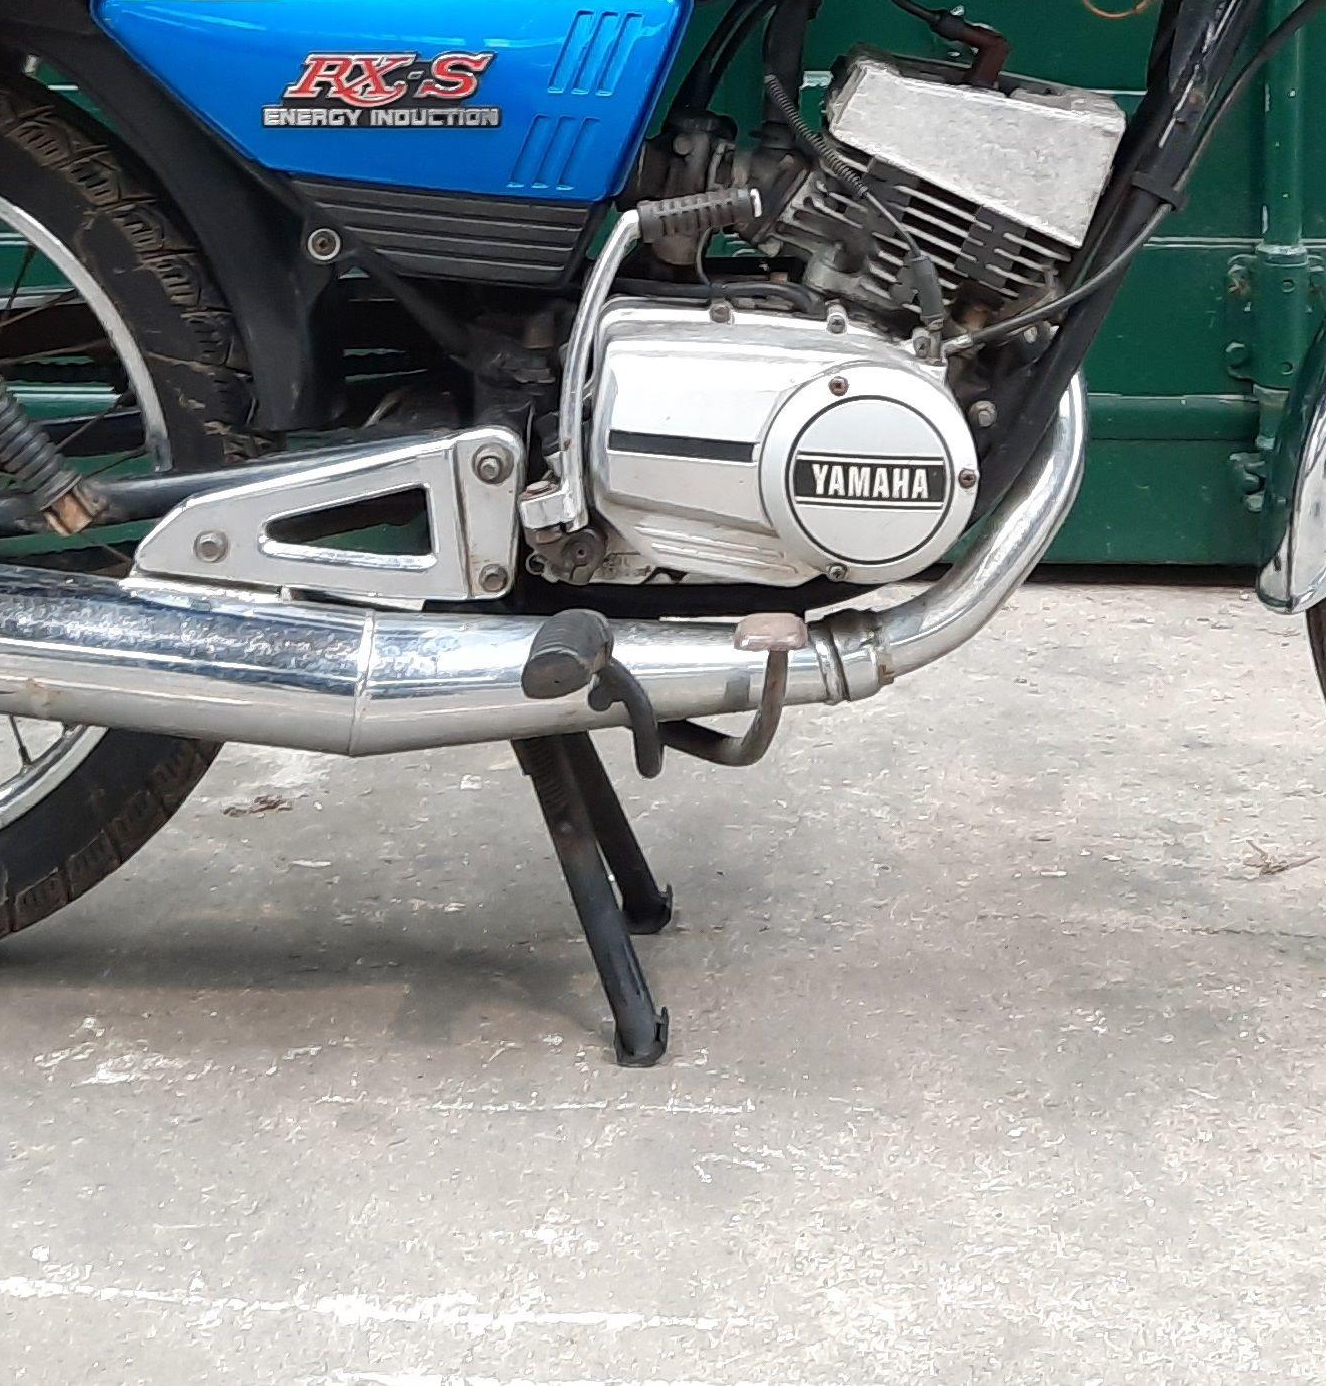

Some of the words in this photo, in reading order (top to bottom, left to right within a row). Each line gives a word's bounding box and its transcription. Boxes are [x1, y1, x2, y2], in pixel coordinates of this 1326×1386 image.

[263, 108, 363, 126] ENERGY
[370, 108, 499, 126] INDUCTION
[812, 464, 929, 499] YAMAHA
